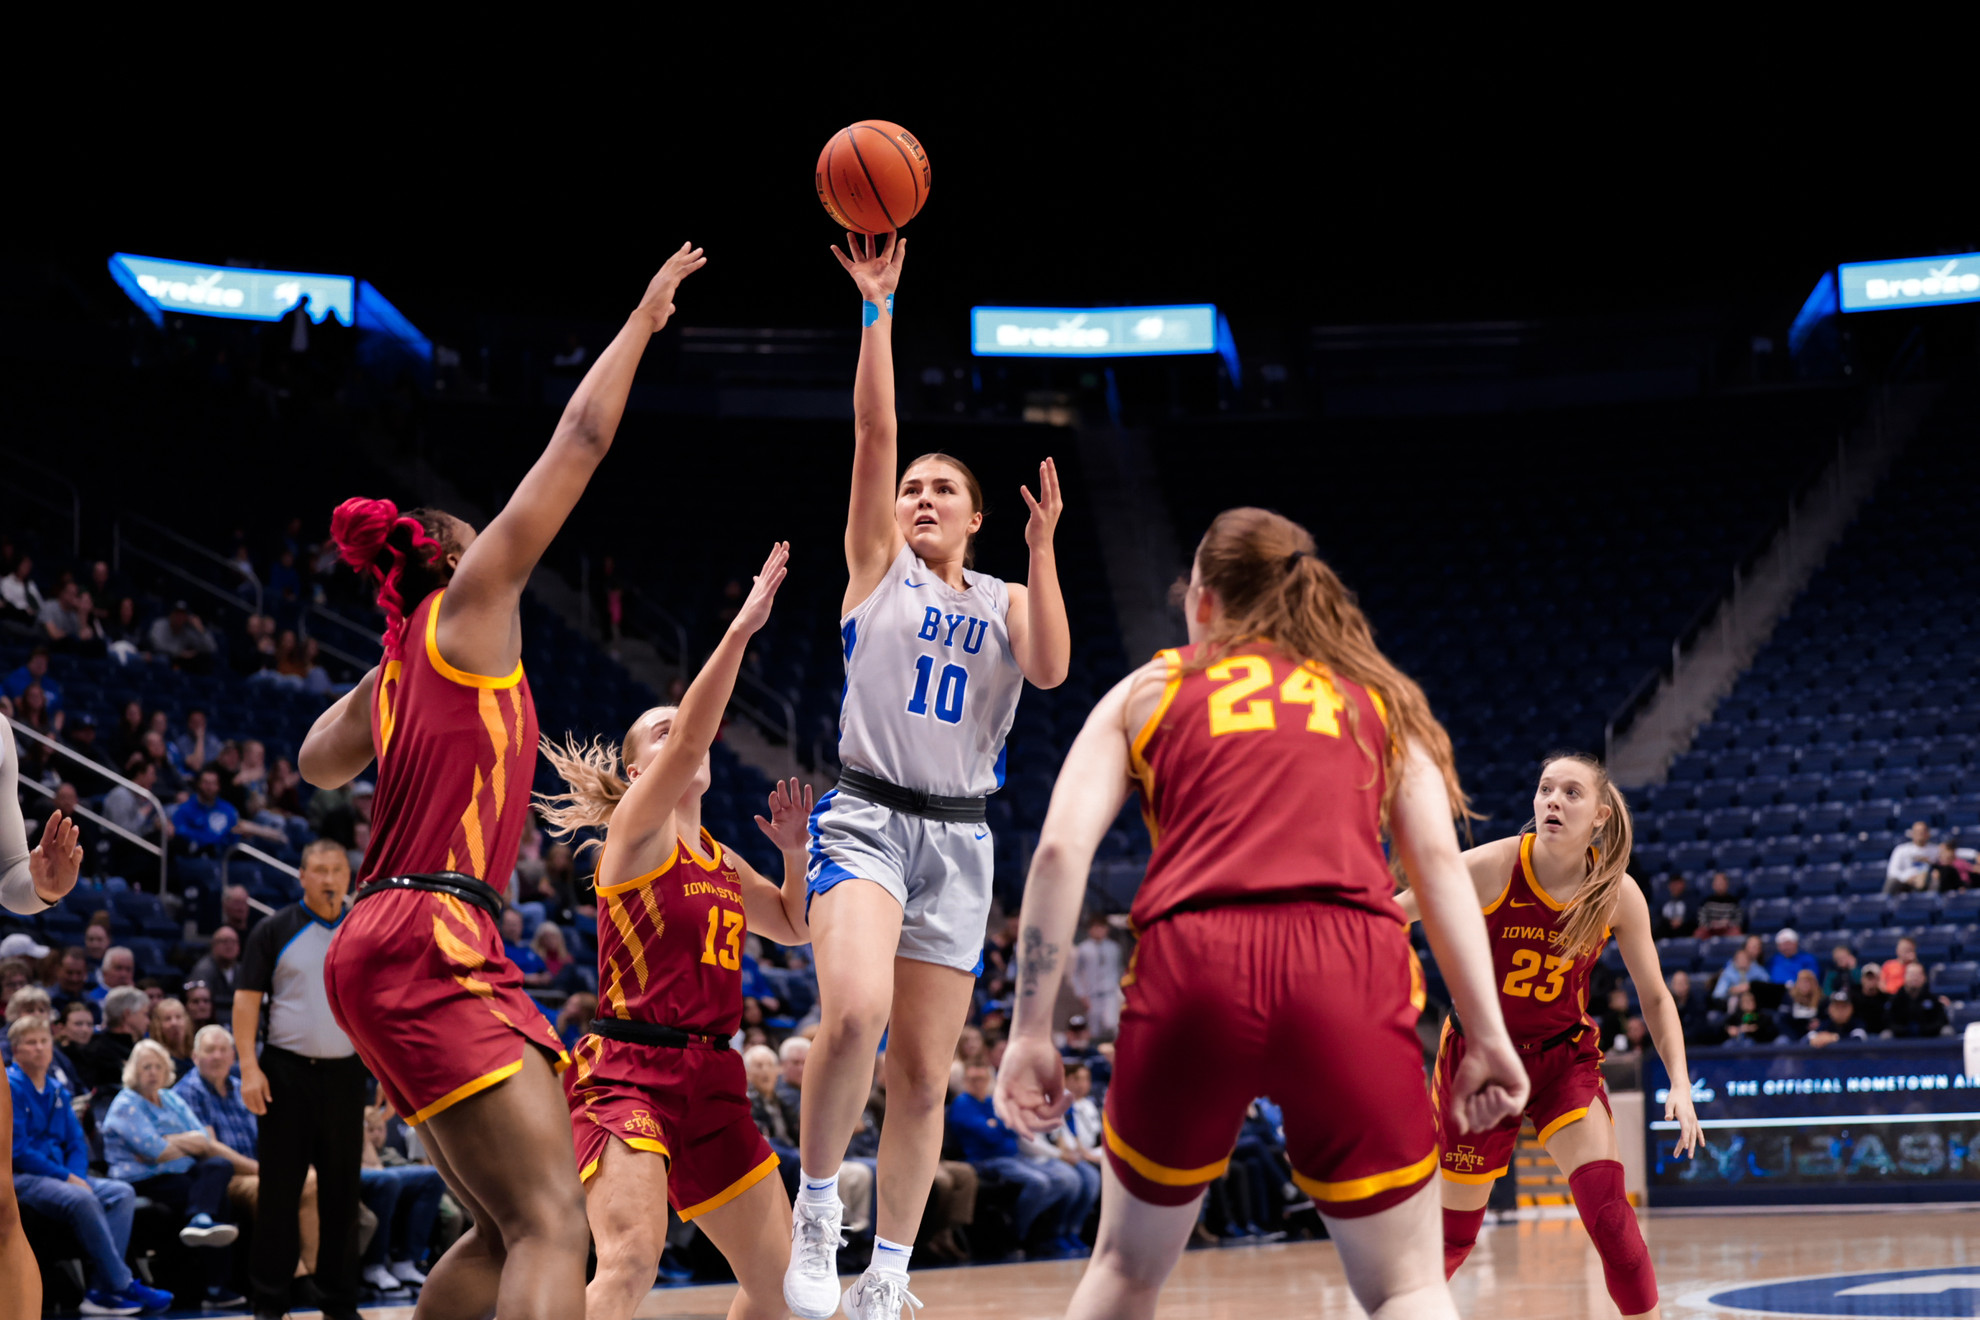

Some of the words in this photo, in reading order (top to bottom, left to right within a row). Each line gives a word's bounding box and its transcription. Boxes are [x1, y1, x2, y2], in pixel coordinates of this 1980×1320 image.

[917, 605, 989, 655] BYU
[904, 653, 969, 726] 10
[1205, 654, 1346, 739] 24
[683, 881, 719, 897] IOWA
[700, 905, 744, 971] 13
[1501, 926, 1545, 941] IOWA
[1502, 948, 1575, 1002] 23
[1725, 1080, 1759, 1097] THE
[1763, 1077, 1842, 1095] OFFICIAL
[1846, 1074, 1949, 1093] HOMETOWN
[1445, 1151, 1485, 1166] STATE
